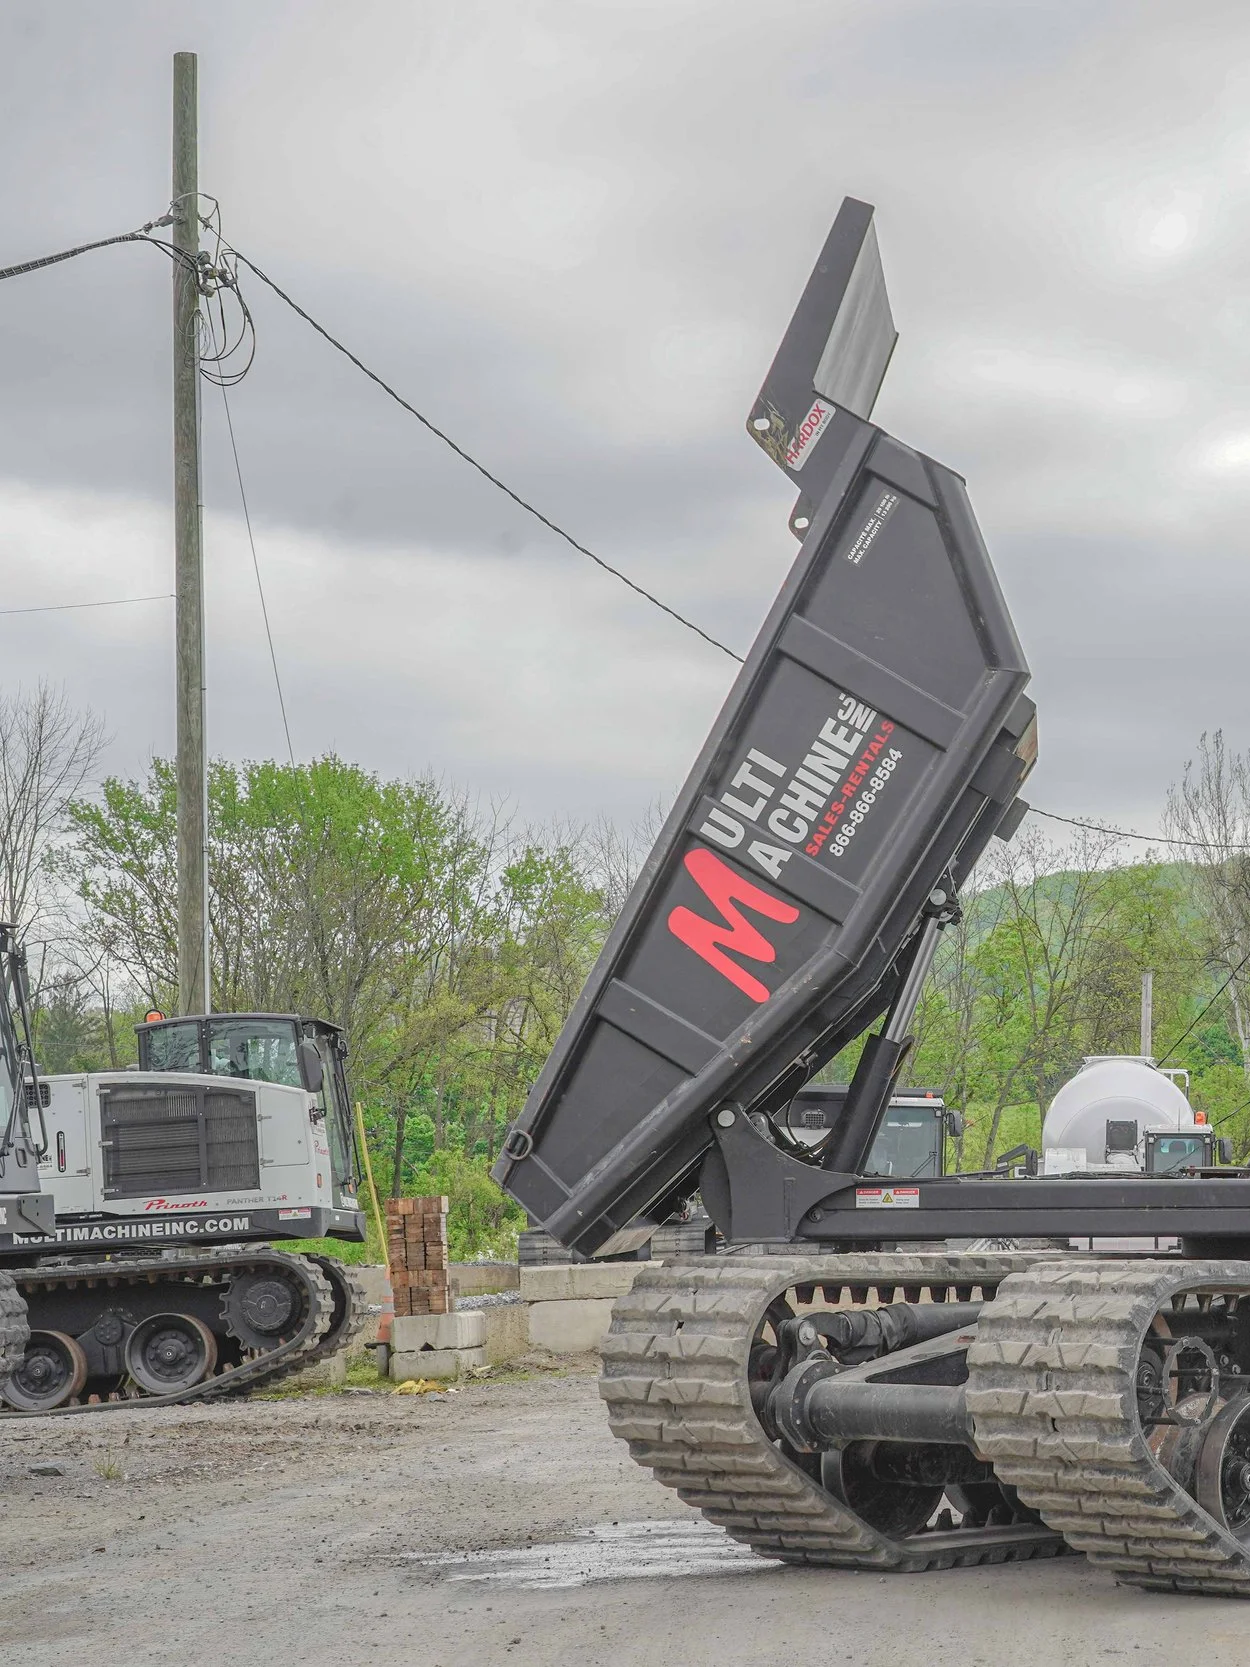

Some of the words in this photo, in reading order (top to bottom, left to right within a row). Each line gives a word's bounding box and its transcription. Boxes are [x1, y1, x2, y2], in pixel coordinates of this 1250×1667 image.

[784, 403, 826, 464] HARDOX
[862, 520, 882, 549] CAPACITY
[805, 720, 896, 857] SALES-RENTALS
[829, 747, 903, 857] 866-866-8584
[143, 1199, 208, 1210] Prinoth
[226, 1197, 264, 1205] PANTHER
